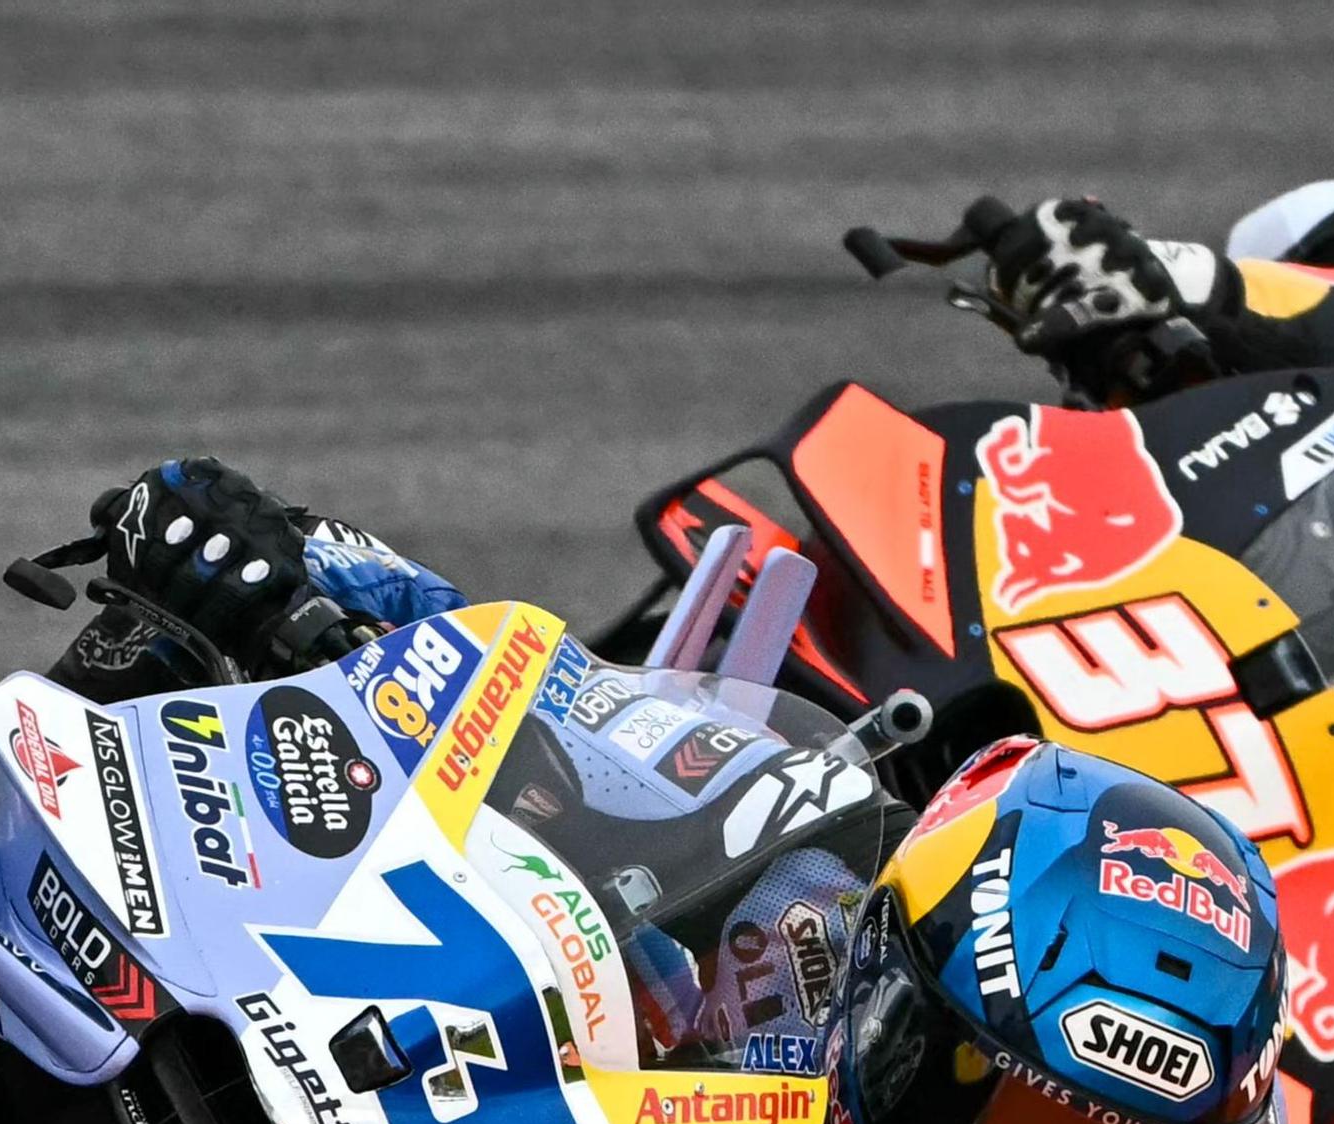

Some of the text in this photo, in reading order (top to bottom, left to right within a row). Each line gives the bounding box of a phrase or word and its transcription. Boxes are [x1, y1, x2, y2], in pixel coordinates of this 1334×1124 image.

[1179, 412, 1271, 482] BAJAJ
[347, 640, 386, 692] NEWS
[374, 621, 464, 742] BK8
[435, 613, 549, 793] Antangin
[19, 703, 58, 813] FEDERAL OIL
[991, 591, 1313, 848] 37
[160, 699, 250, 887] Unibat
[271, 716, 320, 827] Galicia
[301, 713, 351, 832] Estrella
[32, 897, 95, 987] RIDERS
[37, 868, 113, 970] BOLD
[553, 890, 612, 962] AUS
[970, 847, 1021, 999] TONIT
[1099, 858, 1252, 953] Red Bull
[531, 892, 608, 1043] GLOBAL
[785, 917, 829, 1003] SHOE
[742, 1033, 817, 1073] ALEX
[994, 1050, 1072, 1106] GIVES
[1082, 1013, 1200, 1088] SHOEI
